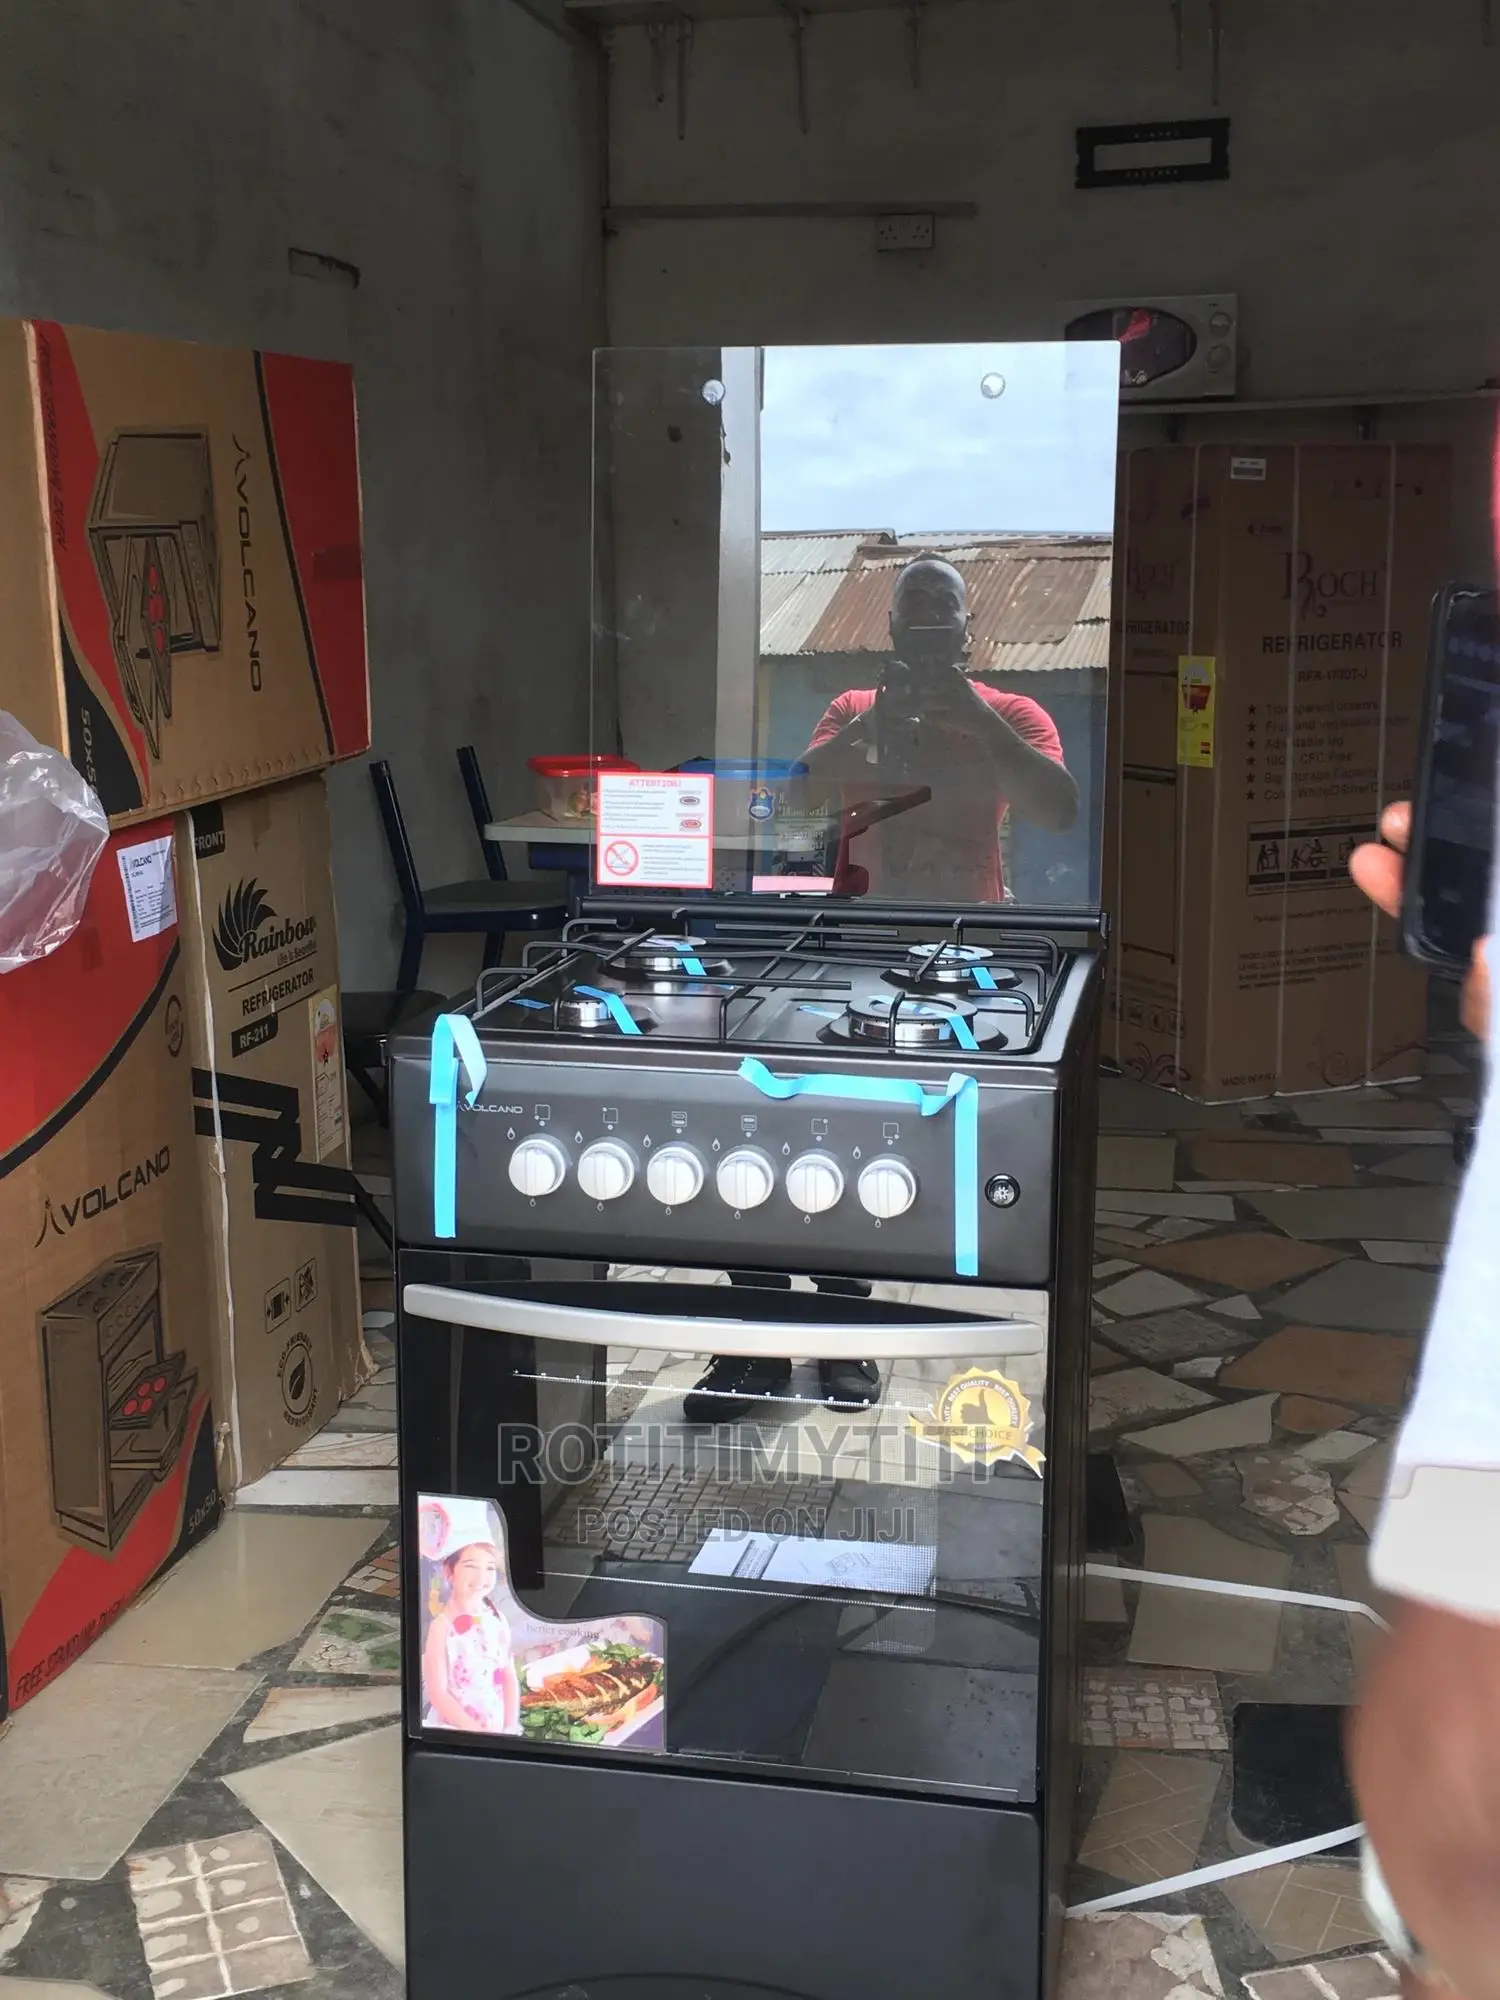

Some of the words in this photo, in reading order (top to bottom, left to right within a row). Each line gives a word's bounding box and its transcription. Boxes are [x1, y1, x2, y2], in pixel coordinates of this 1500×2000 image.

[237, 475, 261, 692] VOLCANO
[81, 706, 99, 792] 50x5
[194, 830, 225, 850] FRONT
[239, 915, 317, 963] Rainbow
[242, 968, 314, 1016] REFRIGERATOR
[239, 1023, 269, 1049] RF-211
[61, 1145, 170, 1227] VOLCANO
[969, 1428, 1013, 1441] CHOICE
[15, 1660, 45, 1702] FREE
